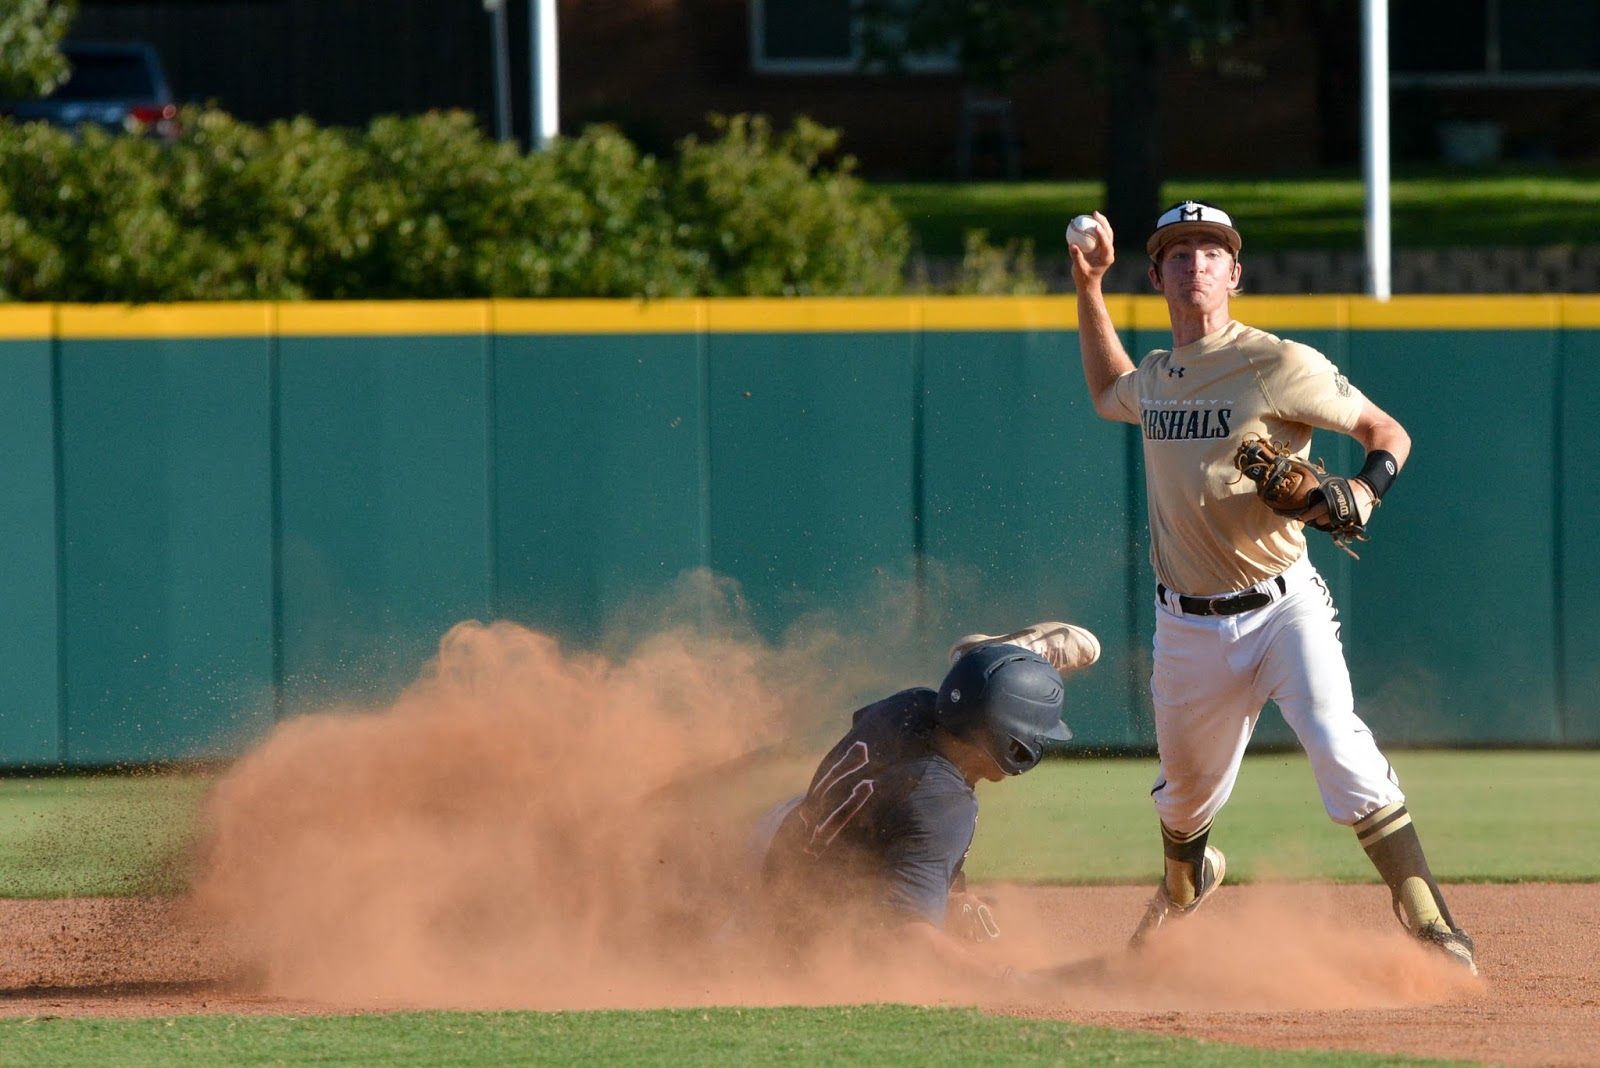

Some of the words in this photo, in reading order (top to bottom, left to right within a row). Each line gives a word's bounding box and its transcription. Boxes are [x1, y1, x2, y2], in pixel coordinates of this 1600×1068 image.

[1180, 206, 1203, 221] M
[1143, 408, 1232, 440] ARSHALS
[1331, 484, 1349, 517] Wilson
